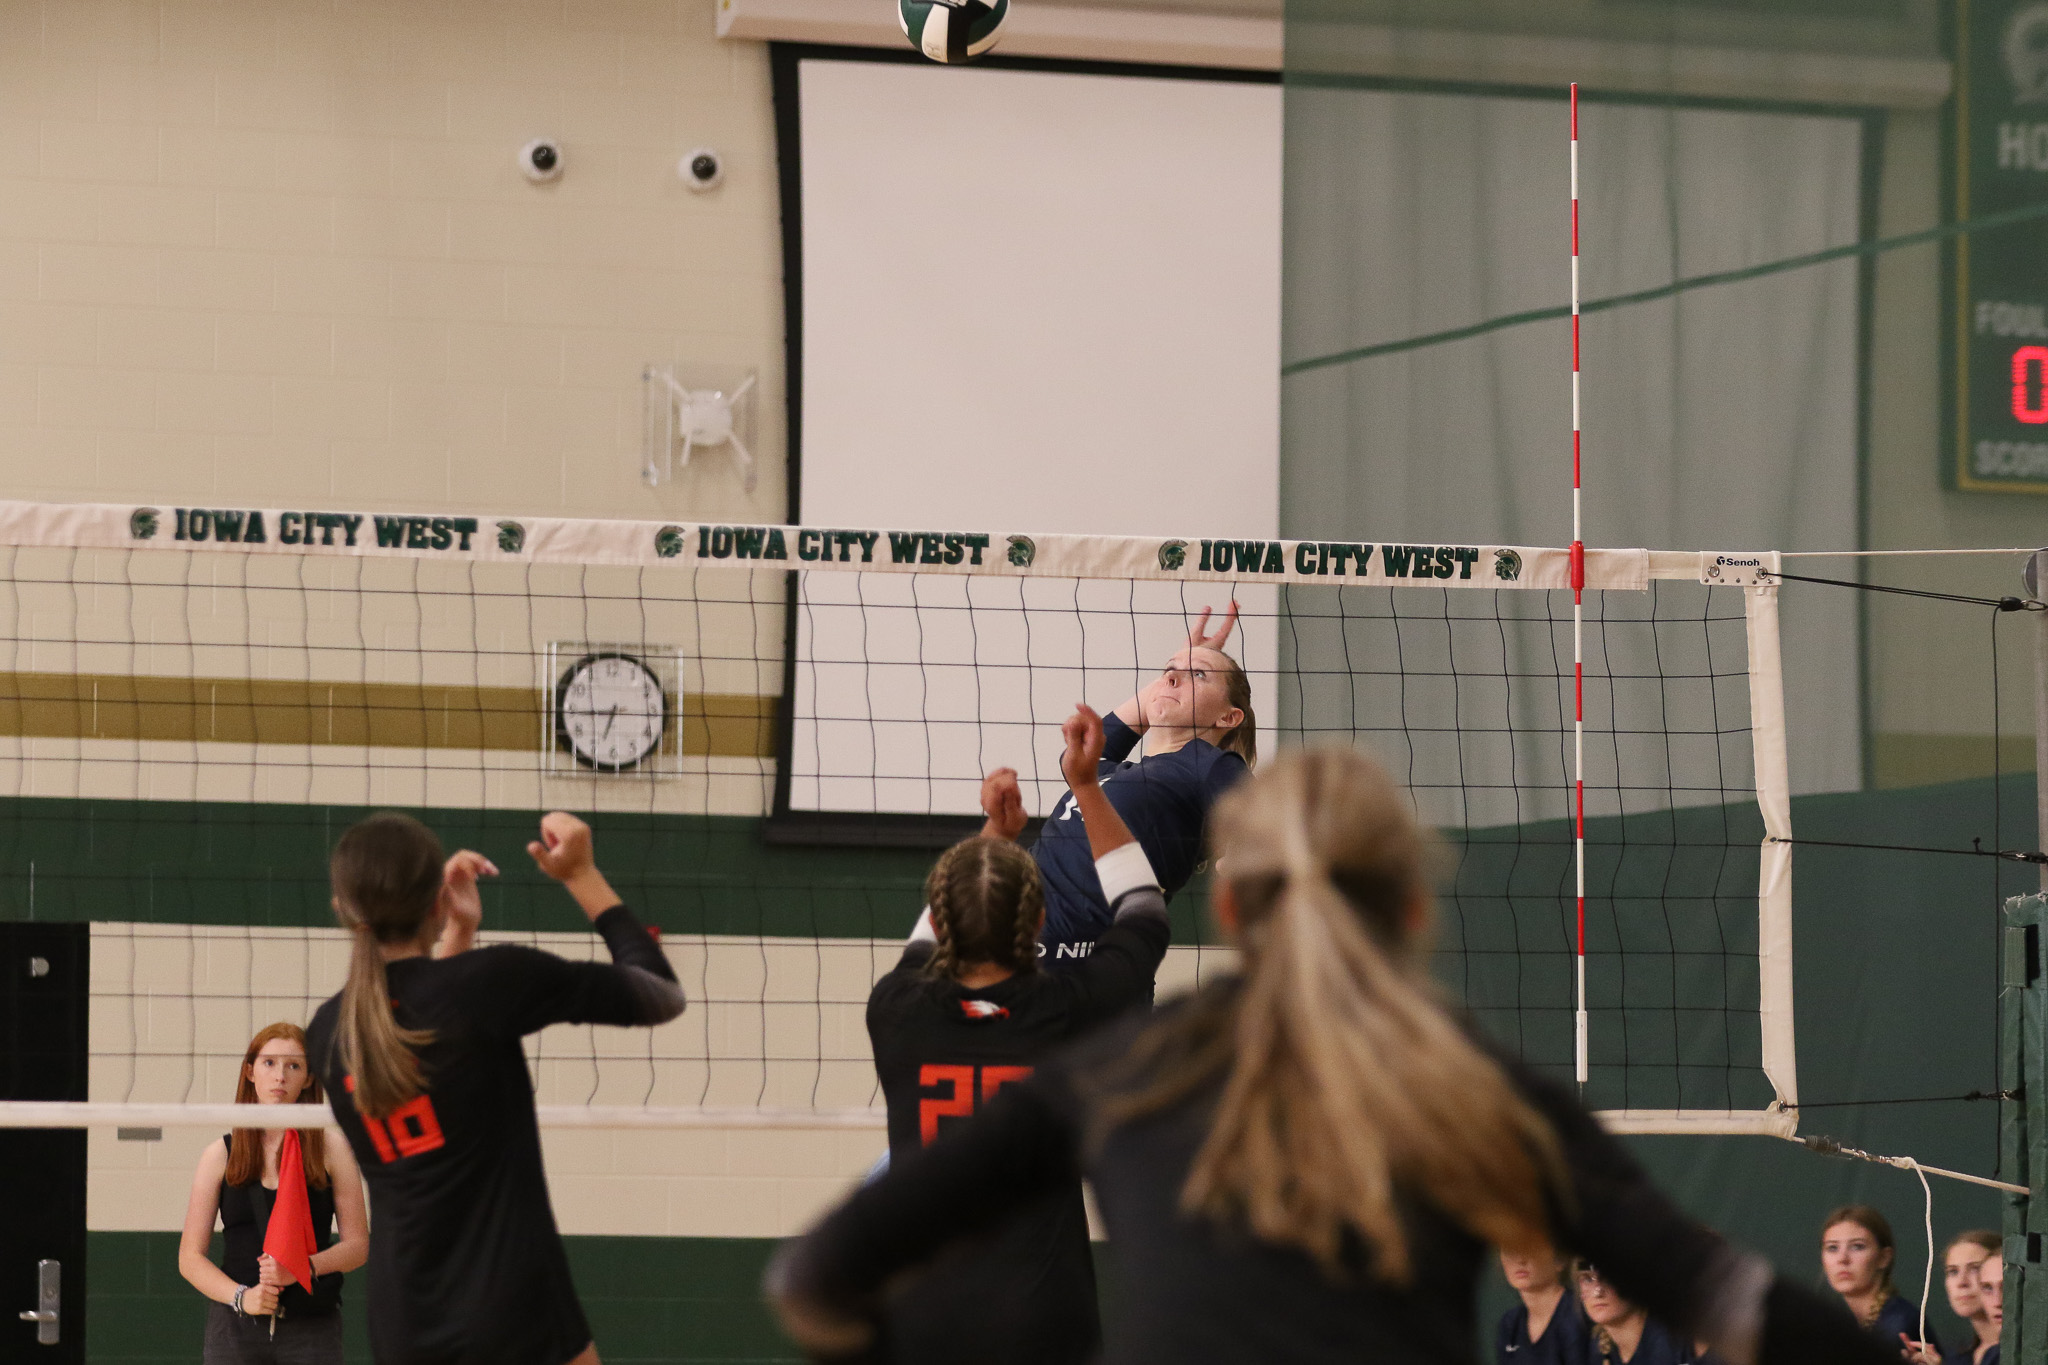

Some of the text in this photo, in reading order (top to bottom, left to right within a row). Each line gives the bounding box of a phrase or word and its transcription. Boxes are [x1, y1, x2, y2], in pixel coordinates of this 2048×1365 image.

[174, 508, 478, 551] IOWA CITY WEST
[698, 525, 990, 565] IOWA CITY WEST
[1200, 539, 1478, 580] IOWA CITY WEST
[1726, 557, 1760, 567] Senoh
